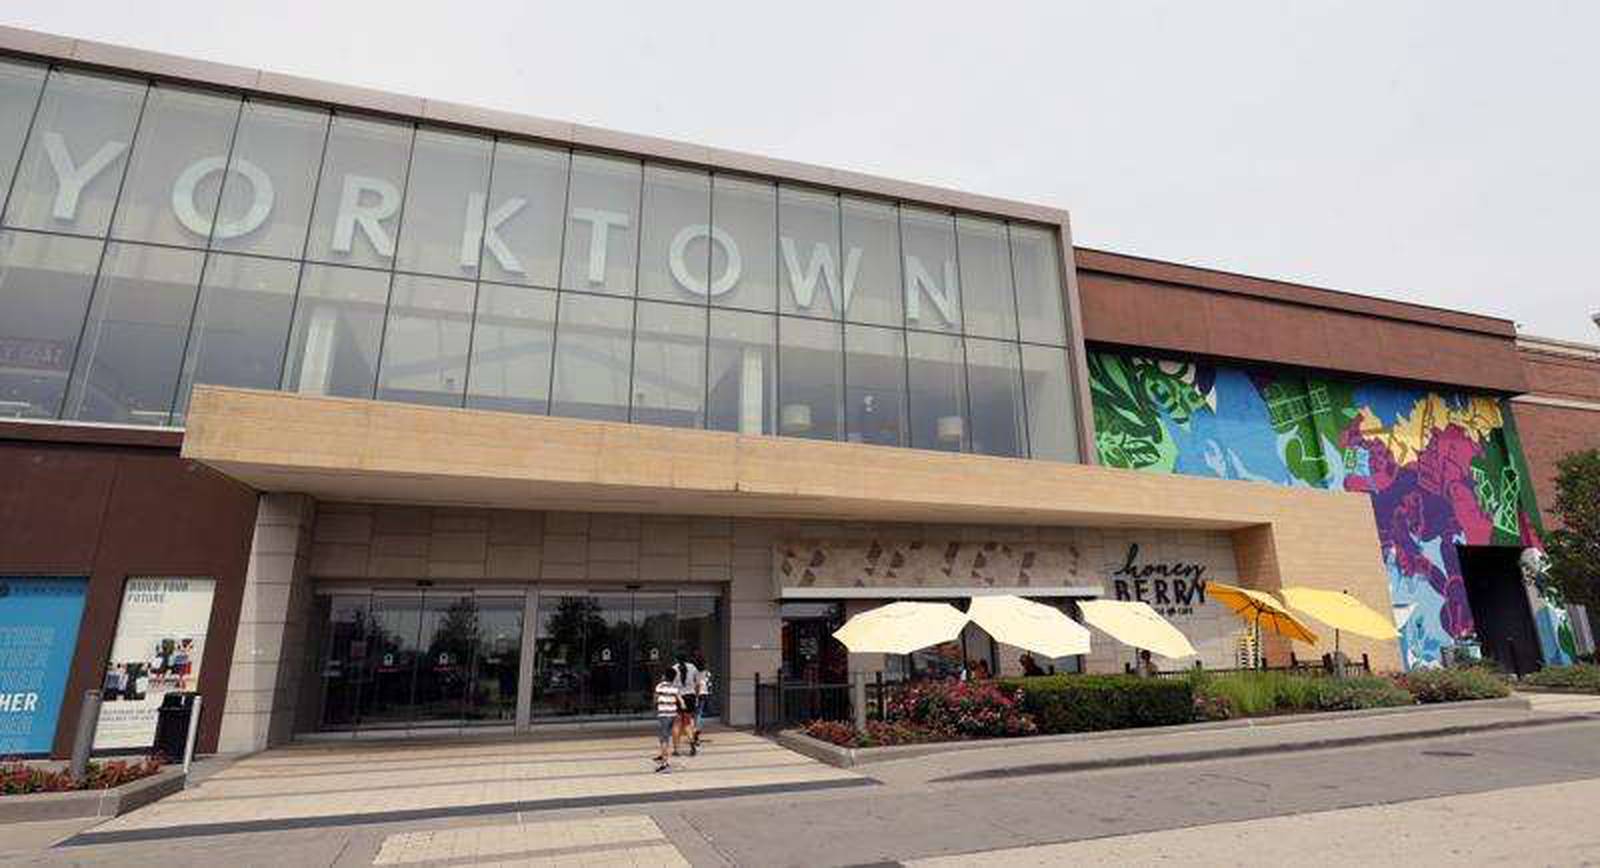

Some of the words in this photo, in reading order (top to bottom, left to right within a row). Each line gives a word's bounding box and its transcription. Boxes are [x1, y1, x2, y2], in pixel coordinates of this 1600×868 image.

[41, 131, 961, 324] YORKTOWN
[1113, 543, 1206, 594] honey
[1114, 579, 1206, 605] BERRY
